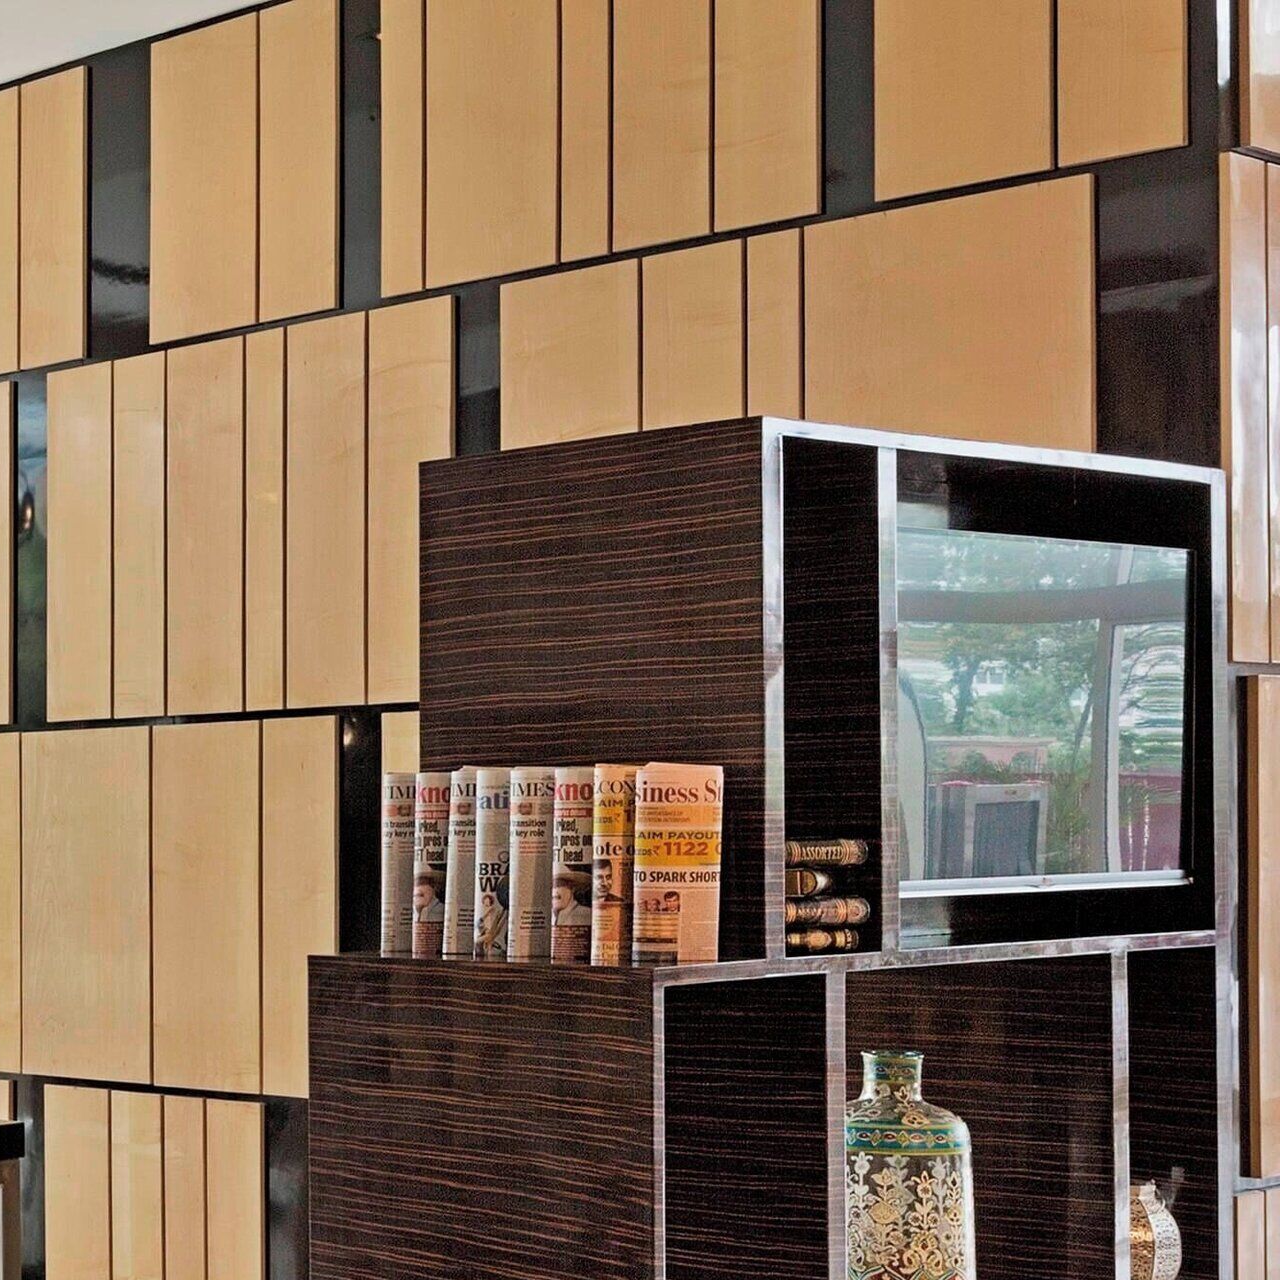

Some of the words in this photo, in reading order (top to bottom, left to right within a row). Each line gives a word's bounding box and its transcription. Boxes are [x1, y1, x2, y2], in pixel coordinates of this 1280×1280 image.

[664, 841, 709, 857] 1122
[801, 846, 844, 860] ASSORTED
[649, 871, 687, 883] SPARK
